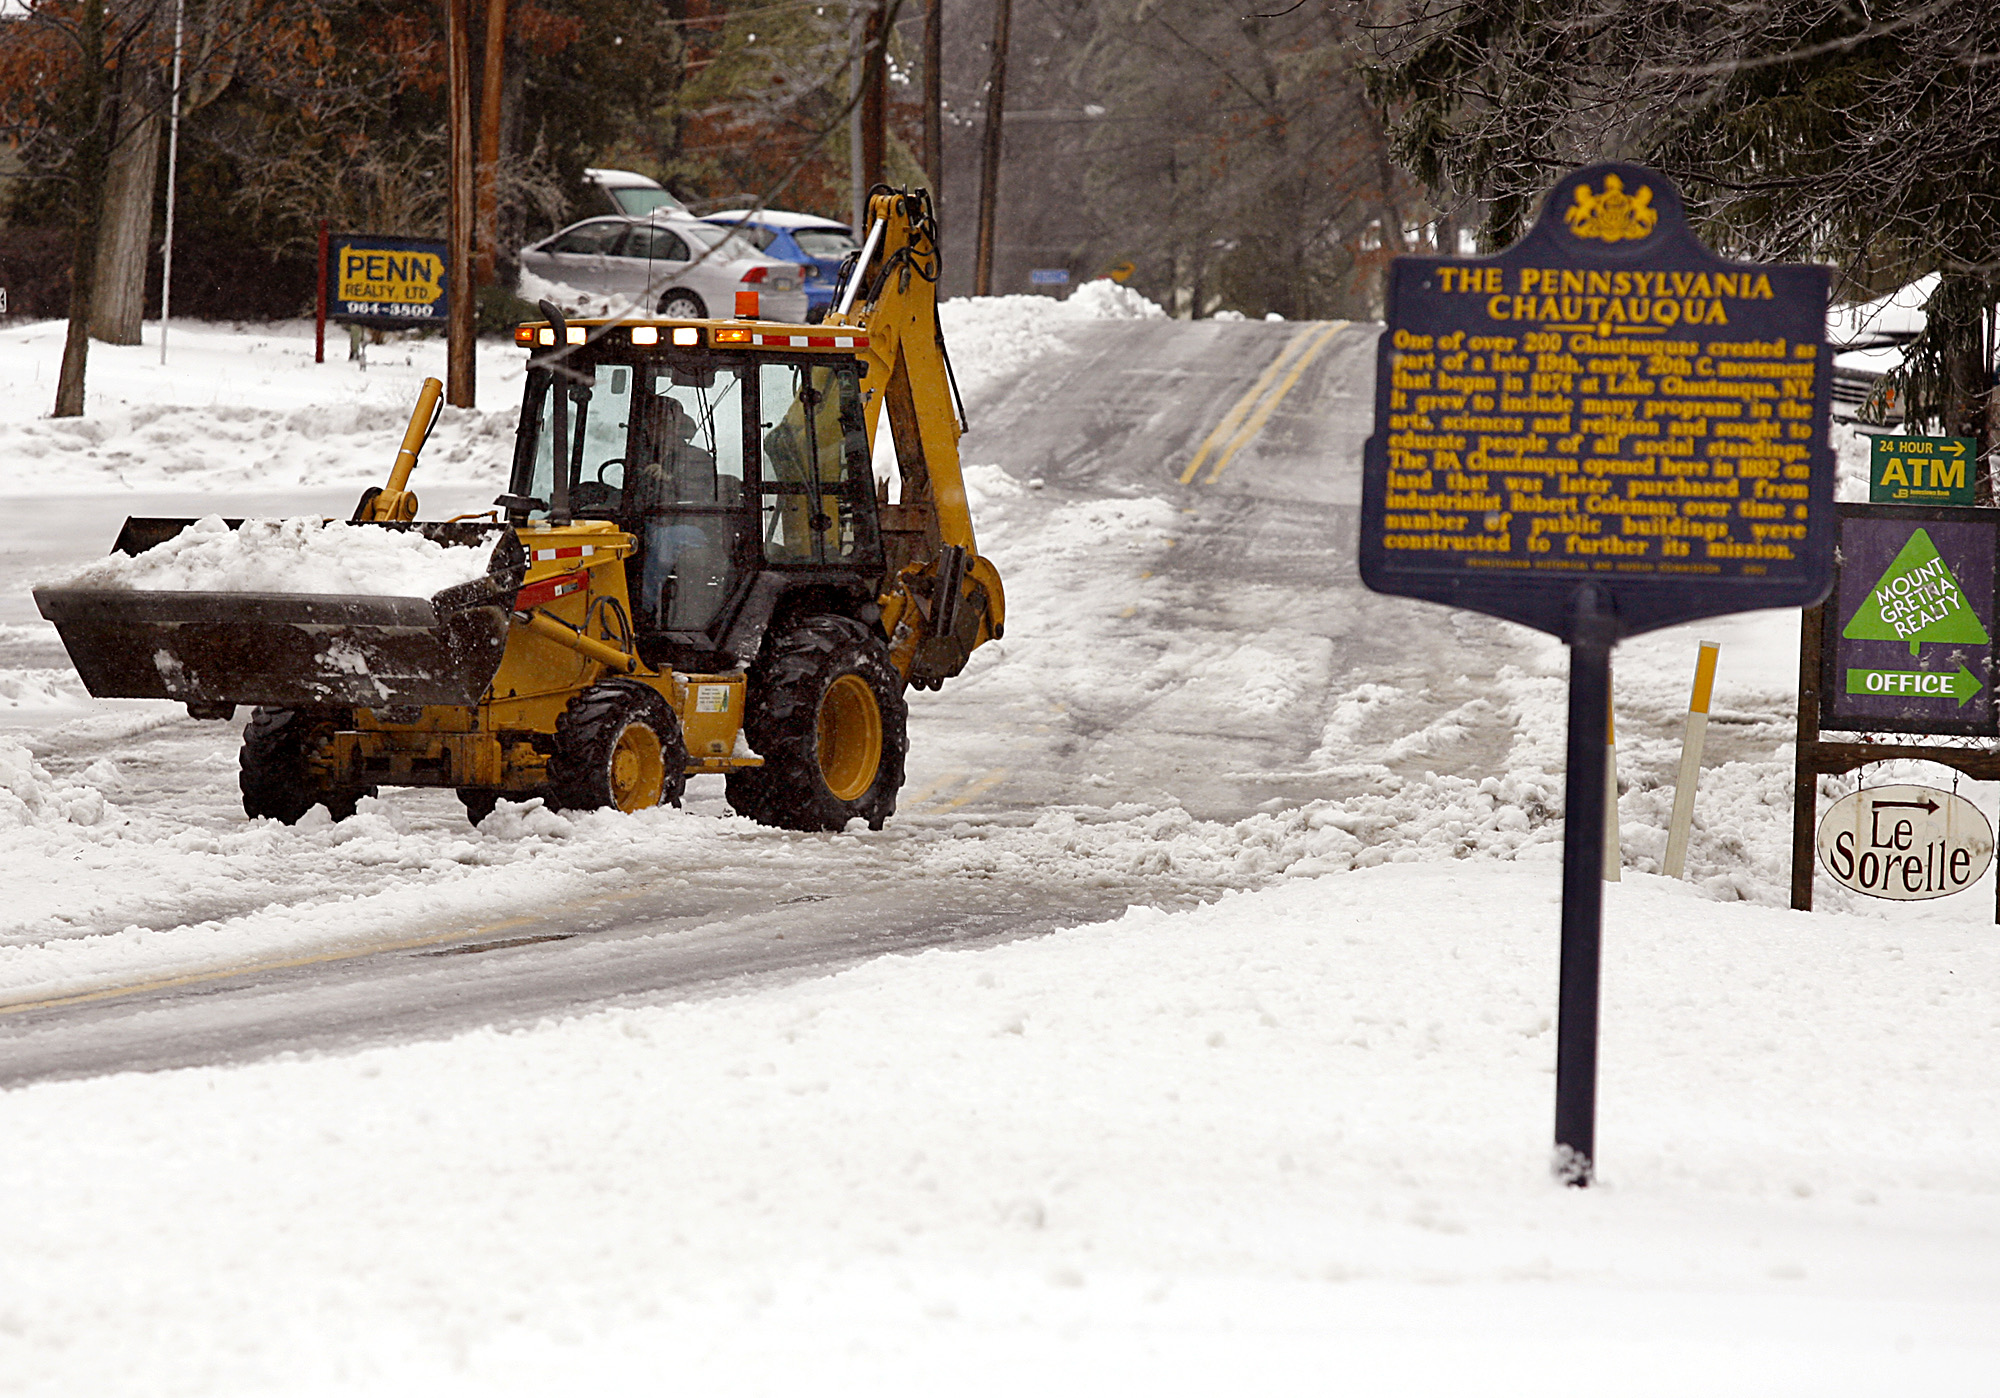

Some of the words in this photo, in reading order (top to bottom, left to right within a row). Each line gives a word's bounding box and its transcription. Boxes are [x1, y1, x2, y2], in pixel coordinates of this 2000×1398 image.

[347, 255, 431, 282] PENN
[1436, 267, 1503, 293] THE
[1519, 268, 1774, 299] PENNSYLVANIA
[1487, 294, 1729, 326] CHAUTAUQUA
[1393, 329, 1433, 349] One
[1438, 330, 1466, 350] of
[1468, 336, 1518, 351] over
[1523, 332, 1562, 353] 200
[1568, 333, 1699, 359] Chautauquas
[1707, 337, 1786, 358] created
[1794, 344, 1817, 359] as
[1392, 353, 1435, 373] part
[1442, 351, 1468, 371] of
[1472, 356, 1485, 371] a
[1491, 352, 1529, 372] late
[1587, 355, 1641, 379] early
[1647, 355, 1692, 376] 20th
[1718, 361, 1815, 377] movement
[1392, 371, 1431, 389] that
[1437, 372, 1496, 395] began
[1503, 373, 1523, 392] in
[1580, 376, 1599, 394] at
[1606, 375, 1655, 395] Lake
[1390, 389, 1407, 409] It
[1415, 395, 1467, 414] grew
[1472, 394, 1495, 411] to
[1500, 392, 1574, 413] include
[1581, 399, 1637, 419] many
[1644, 400, 1742, 420] programs
[1750, 397, 1772, 417] in
[1778, 399, 1813, 419] the
[1388, 429, 1467, 450] educate
[1478, 432, 1548, 457] people
[1555, 434, 1584, 453] of
[1593, 434, 1619, 454] all
[1634, 436, 1694, 456] social
[1531, 414, 1571, 433] and
[1580, 415, 1660, 439] religion
[1668, 416, 1707, 436] and
[1714, 419, 1782, 442] sought
[1789, 421, 1812, 439] to
[1879, 440, 1895, 452] 24
[1900, 441, 1934, 454] HOUR
[1388, 449, 1427, 469] The
[1433, 450, 1462, 470] PA
[1466, 450, 1578, 476] Chautauqua
[1583, 456, 1655, 477] opened
[1661, 457, 1709, 476] here
[1712, 458, 1734, 477] in
[1783, 464, 1810, 479] on
[1879, 457, 1966, 489] ATM
[1387, 469, 1432, 490] land
[1446, 471, 1488, 490] that
[1504, 477, 1543, 491] was
[1559, 473, 1612, 494] later
[1627, 476, 1739, 498] purchased
[1753, 478, 1809, 499] from
[1385, 489, 1501, 511] industrialist
[1510, 492, 1578, 513] Robert
[1682, 501, 1732, 517] over
[1739, 498, 1786, 519] time
[1793, 504, 1808, 519] a
[1384, 510, 1469, 530] number
[1484, 511, 1513, 532] of
[1531, 513, 1602, 536] public
[1622, 515, 1728, 541] buildings
[1751, 523, 1807, 539] were
[1383, 532, 1511, 551] constructed
[1527, 535, 1551, 552] to
[1565, 534, 1649, 556] further
[1662, 535, 1690, 556] its
[1707, 537, 1795, 559] mission.
[1875, 556, 1944, 606] MOUNT
[1880, 577, 1956, 623] GRETNA
[1894, 591, 1961, 639] REALTY
[1866, 672, 1955, 694] OFFICE
[1871, 811, 1913, 851] Le
[1830, 831, 1970, 892] Sorelle
